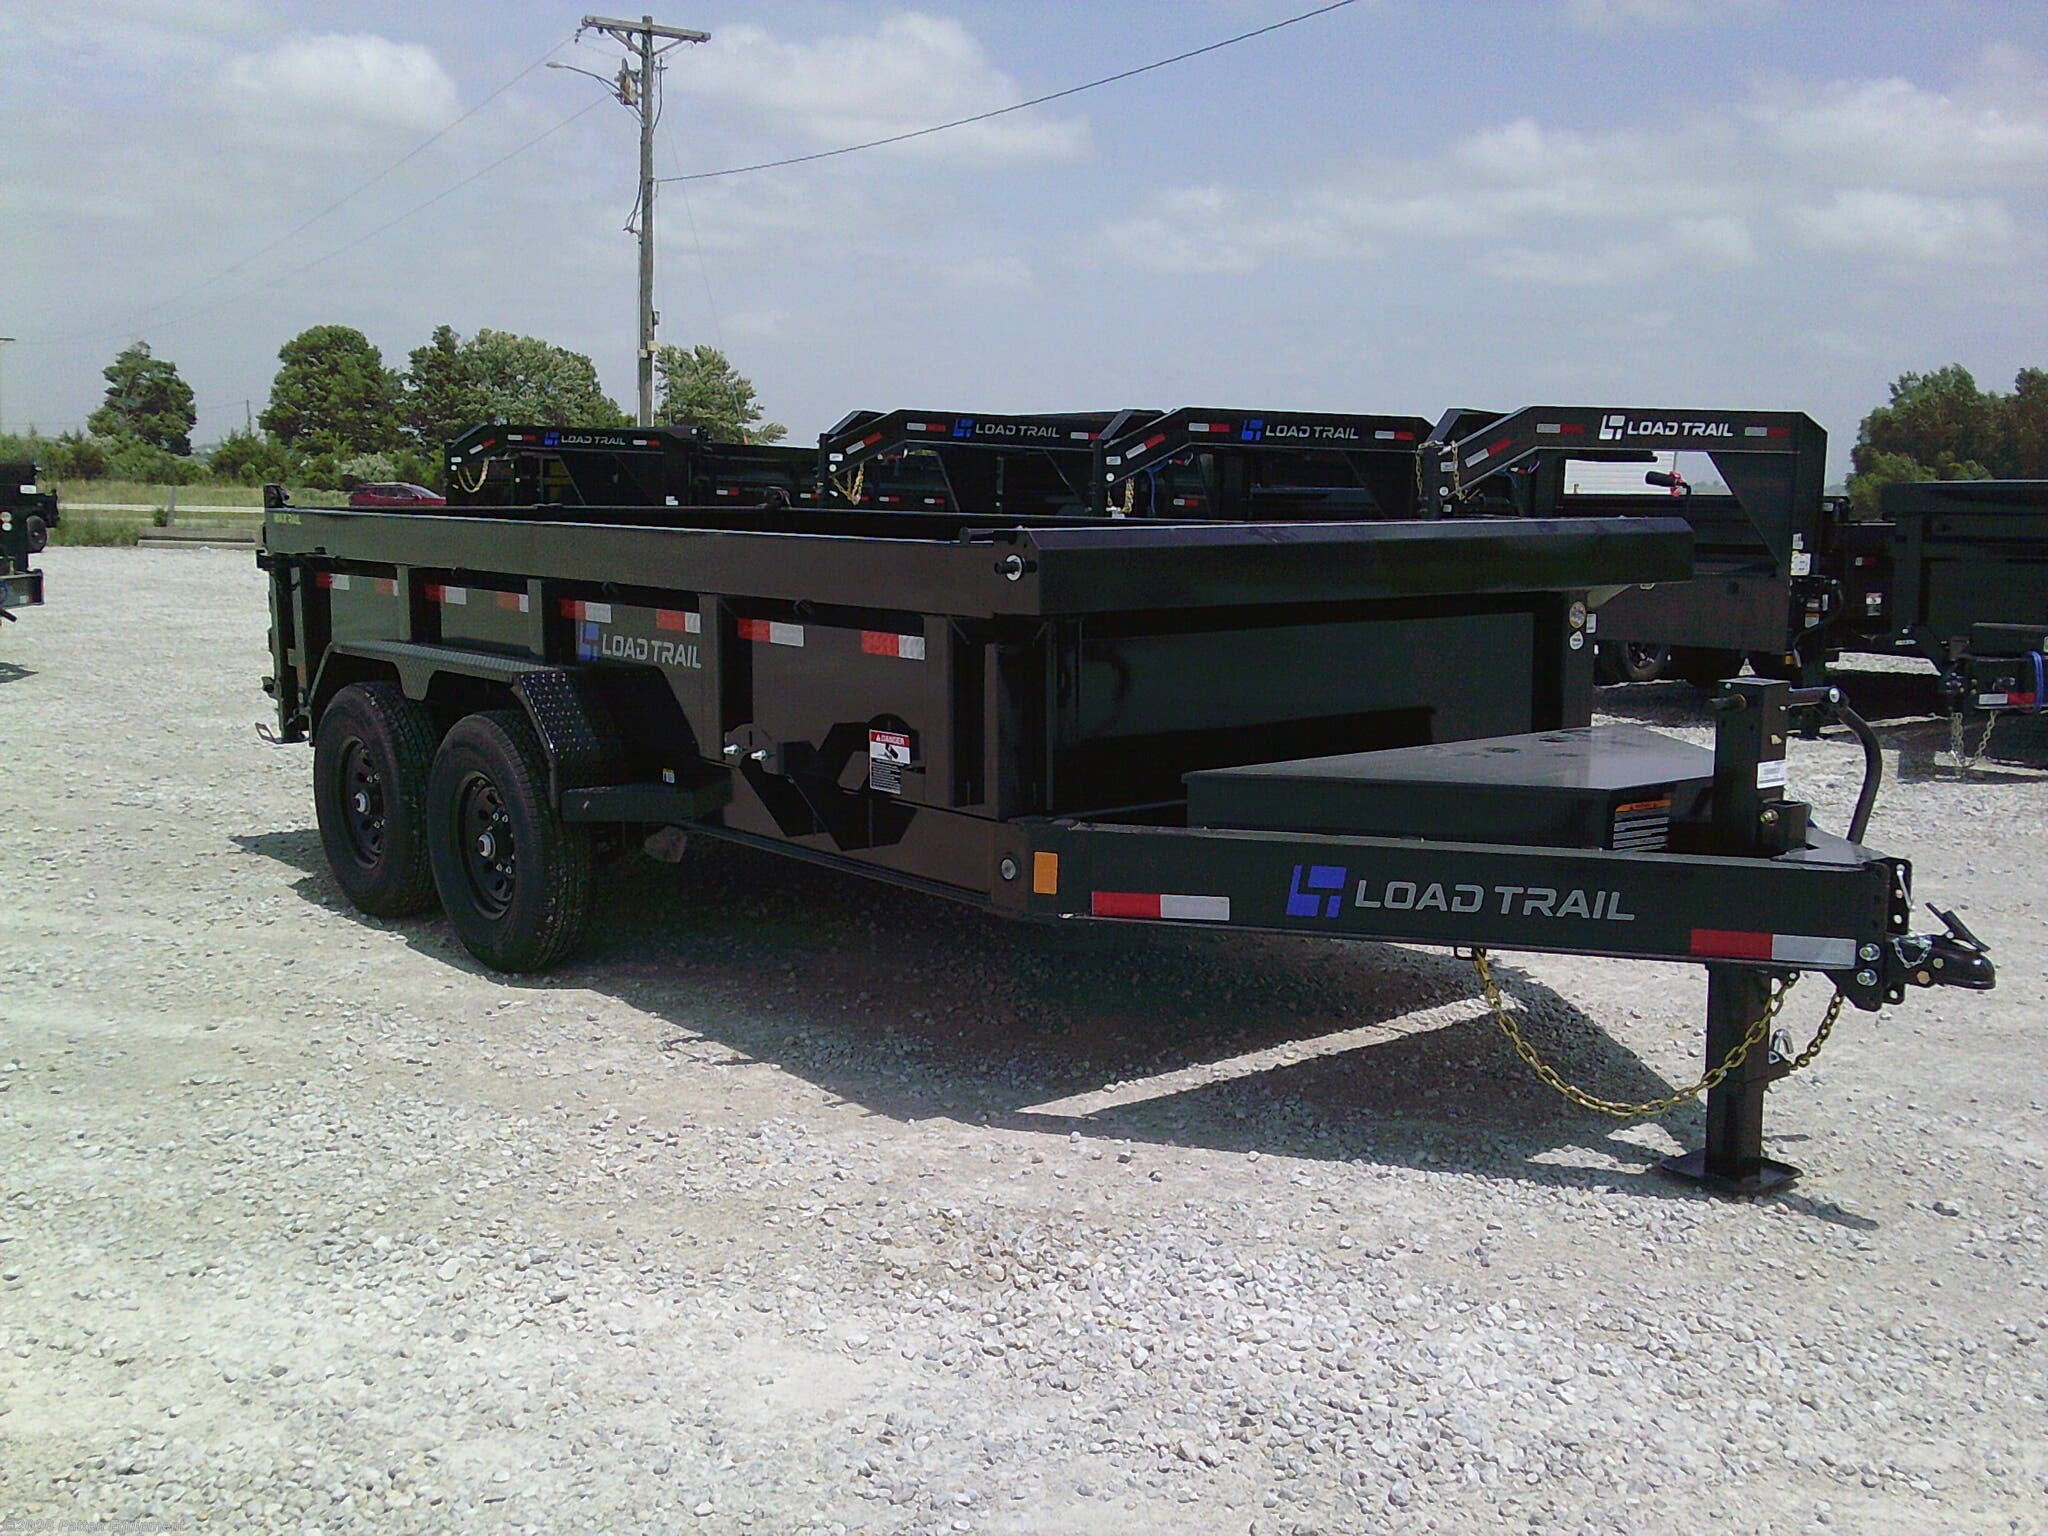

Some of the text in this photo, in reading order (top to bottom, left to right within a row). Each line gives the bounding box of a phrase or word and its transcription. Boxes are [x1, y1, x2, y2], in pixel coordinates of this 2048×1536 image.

[975, 423, 1061, 438] LOAD TRAIL
[1265, 424, 1359, 440] LOAD TRAIL
[1627, 420, 1734, 437] LOAD TRAIL
[560, 434, 627, 446] LOAD TRAIL
[602, 633, 702, 669] LOAD TRAIL
[1354, 879, 1636, 922] LOAD TRAIL
